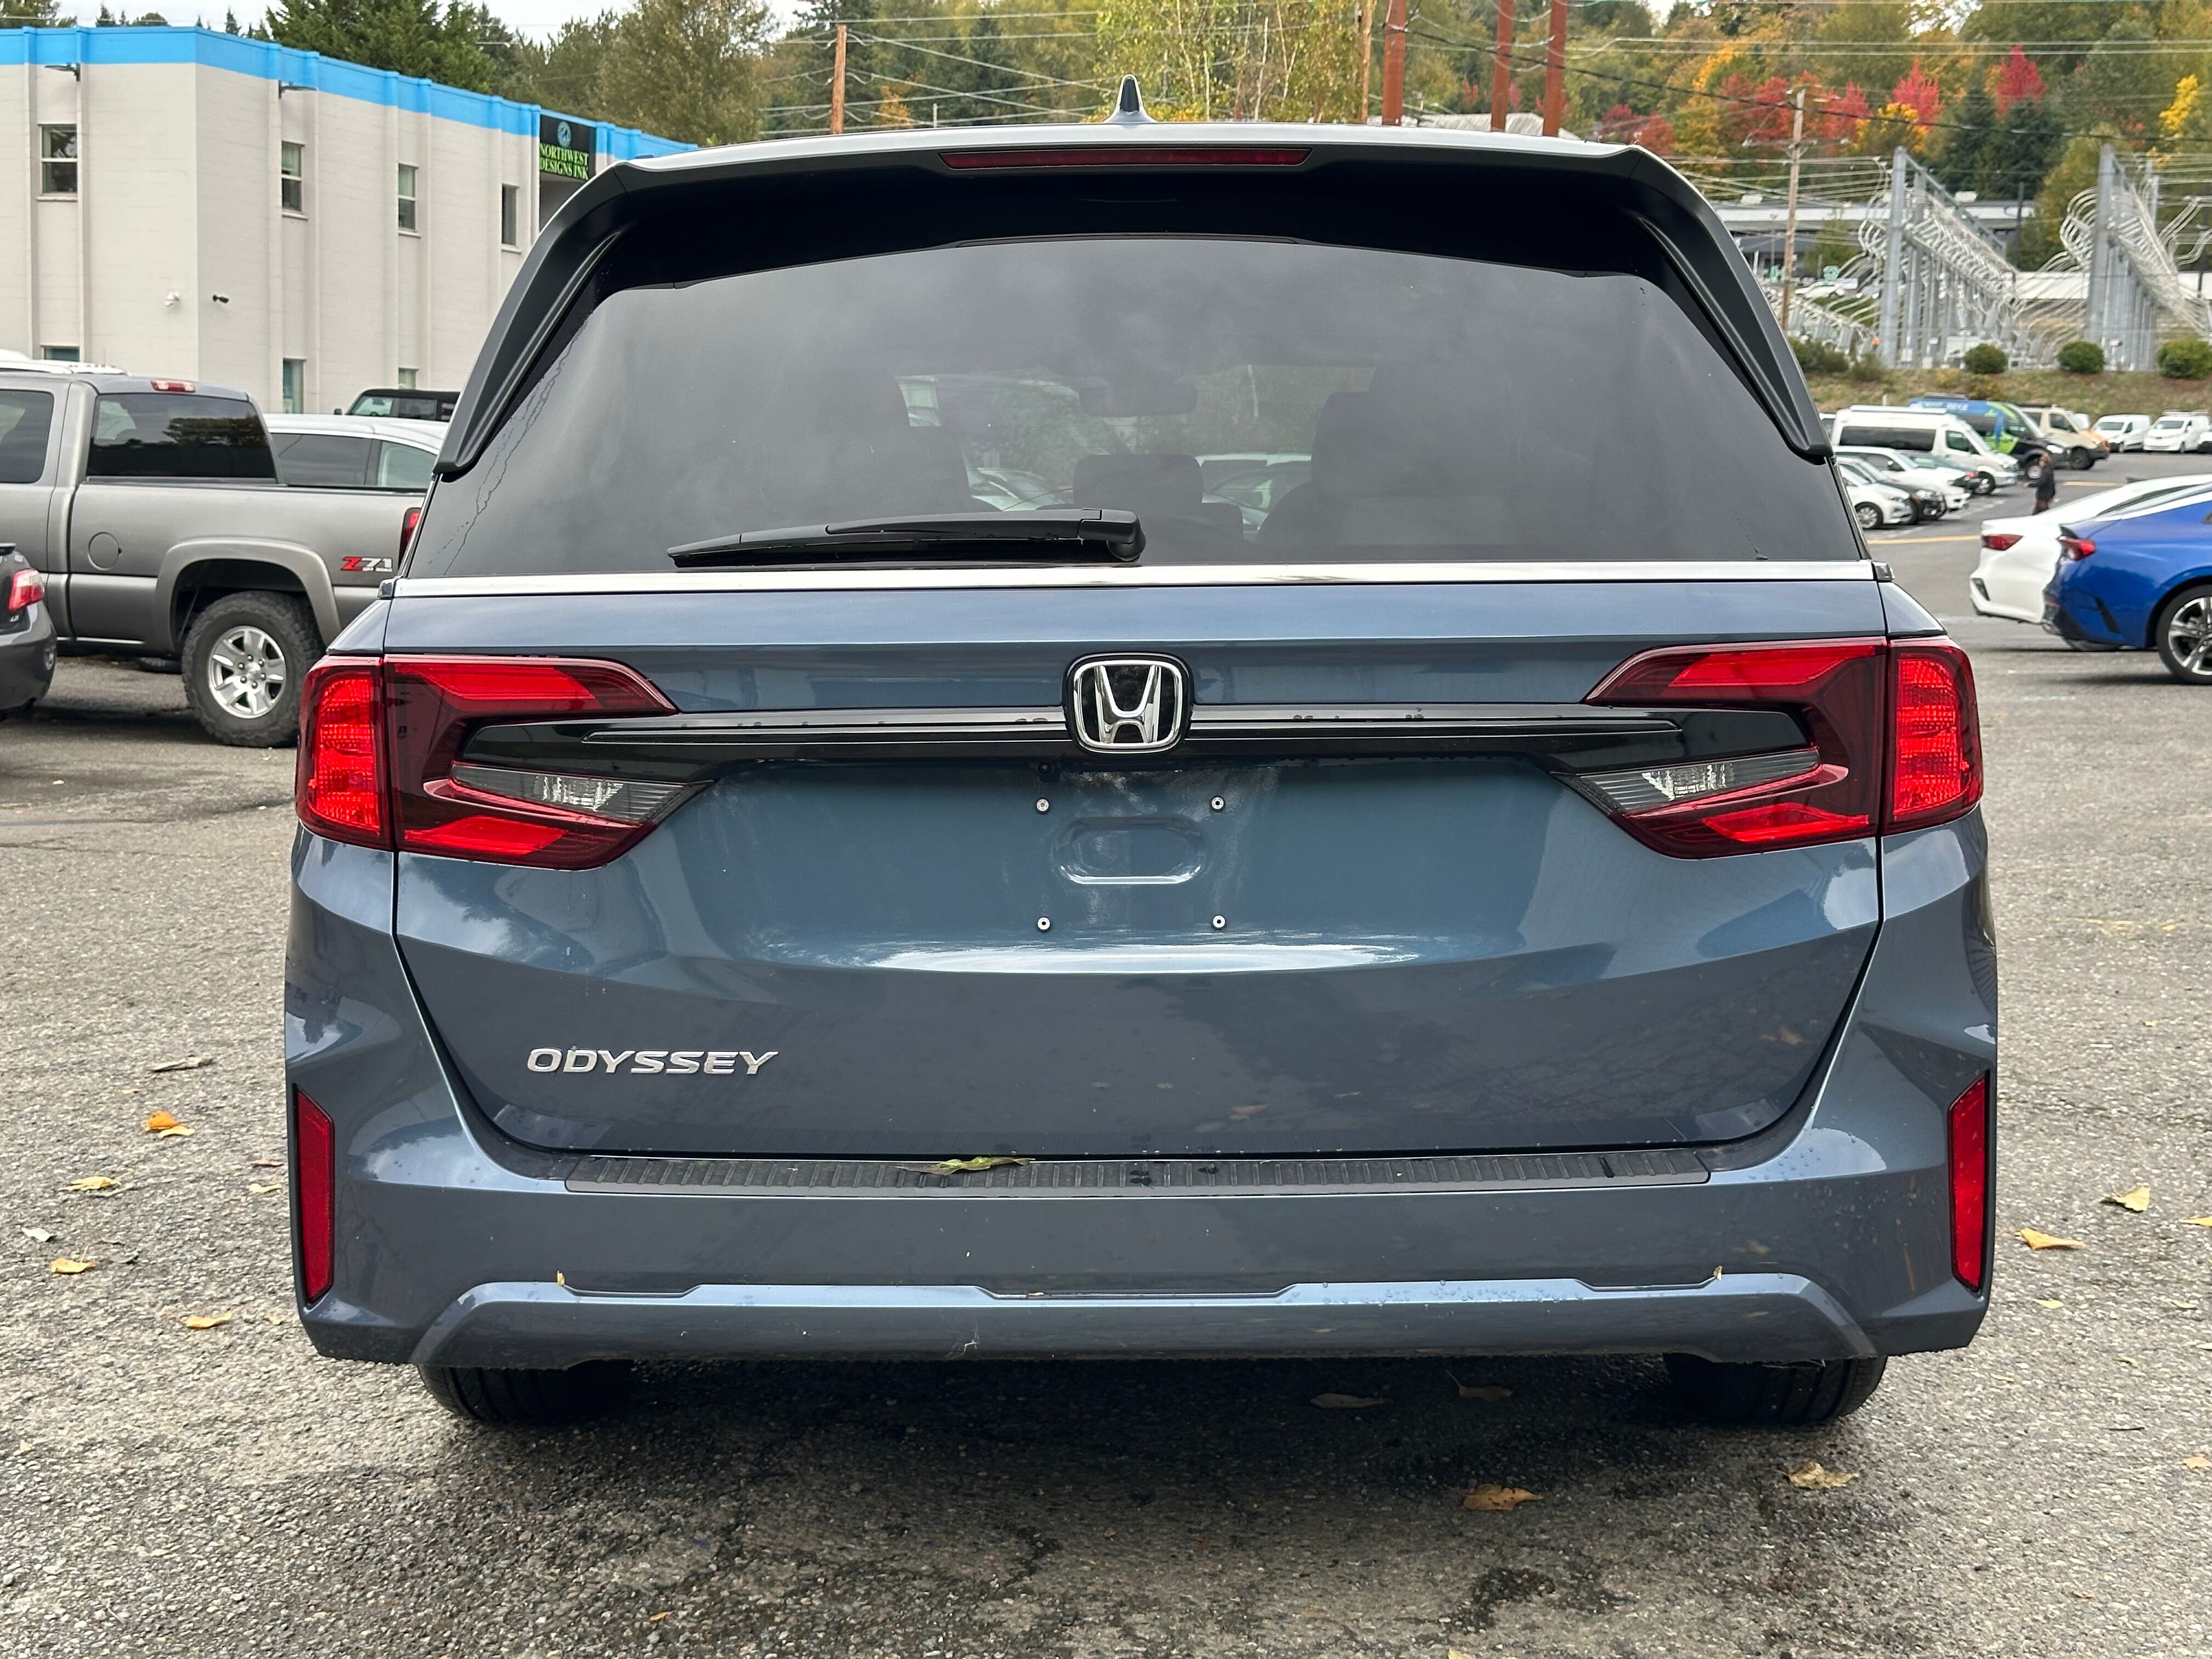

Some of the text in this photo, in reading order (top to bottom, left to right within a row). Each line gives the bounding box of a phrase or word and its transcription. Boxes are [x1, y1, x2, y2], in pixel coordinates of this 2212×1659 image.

[540, 143, 589, 166] NORTHWEST
[540, 157, 589, 180] DESIGNS INK
[341, 556, 393, 572] Z71
[527, 1047, 778, 1075] ODYSSEY
